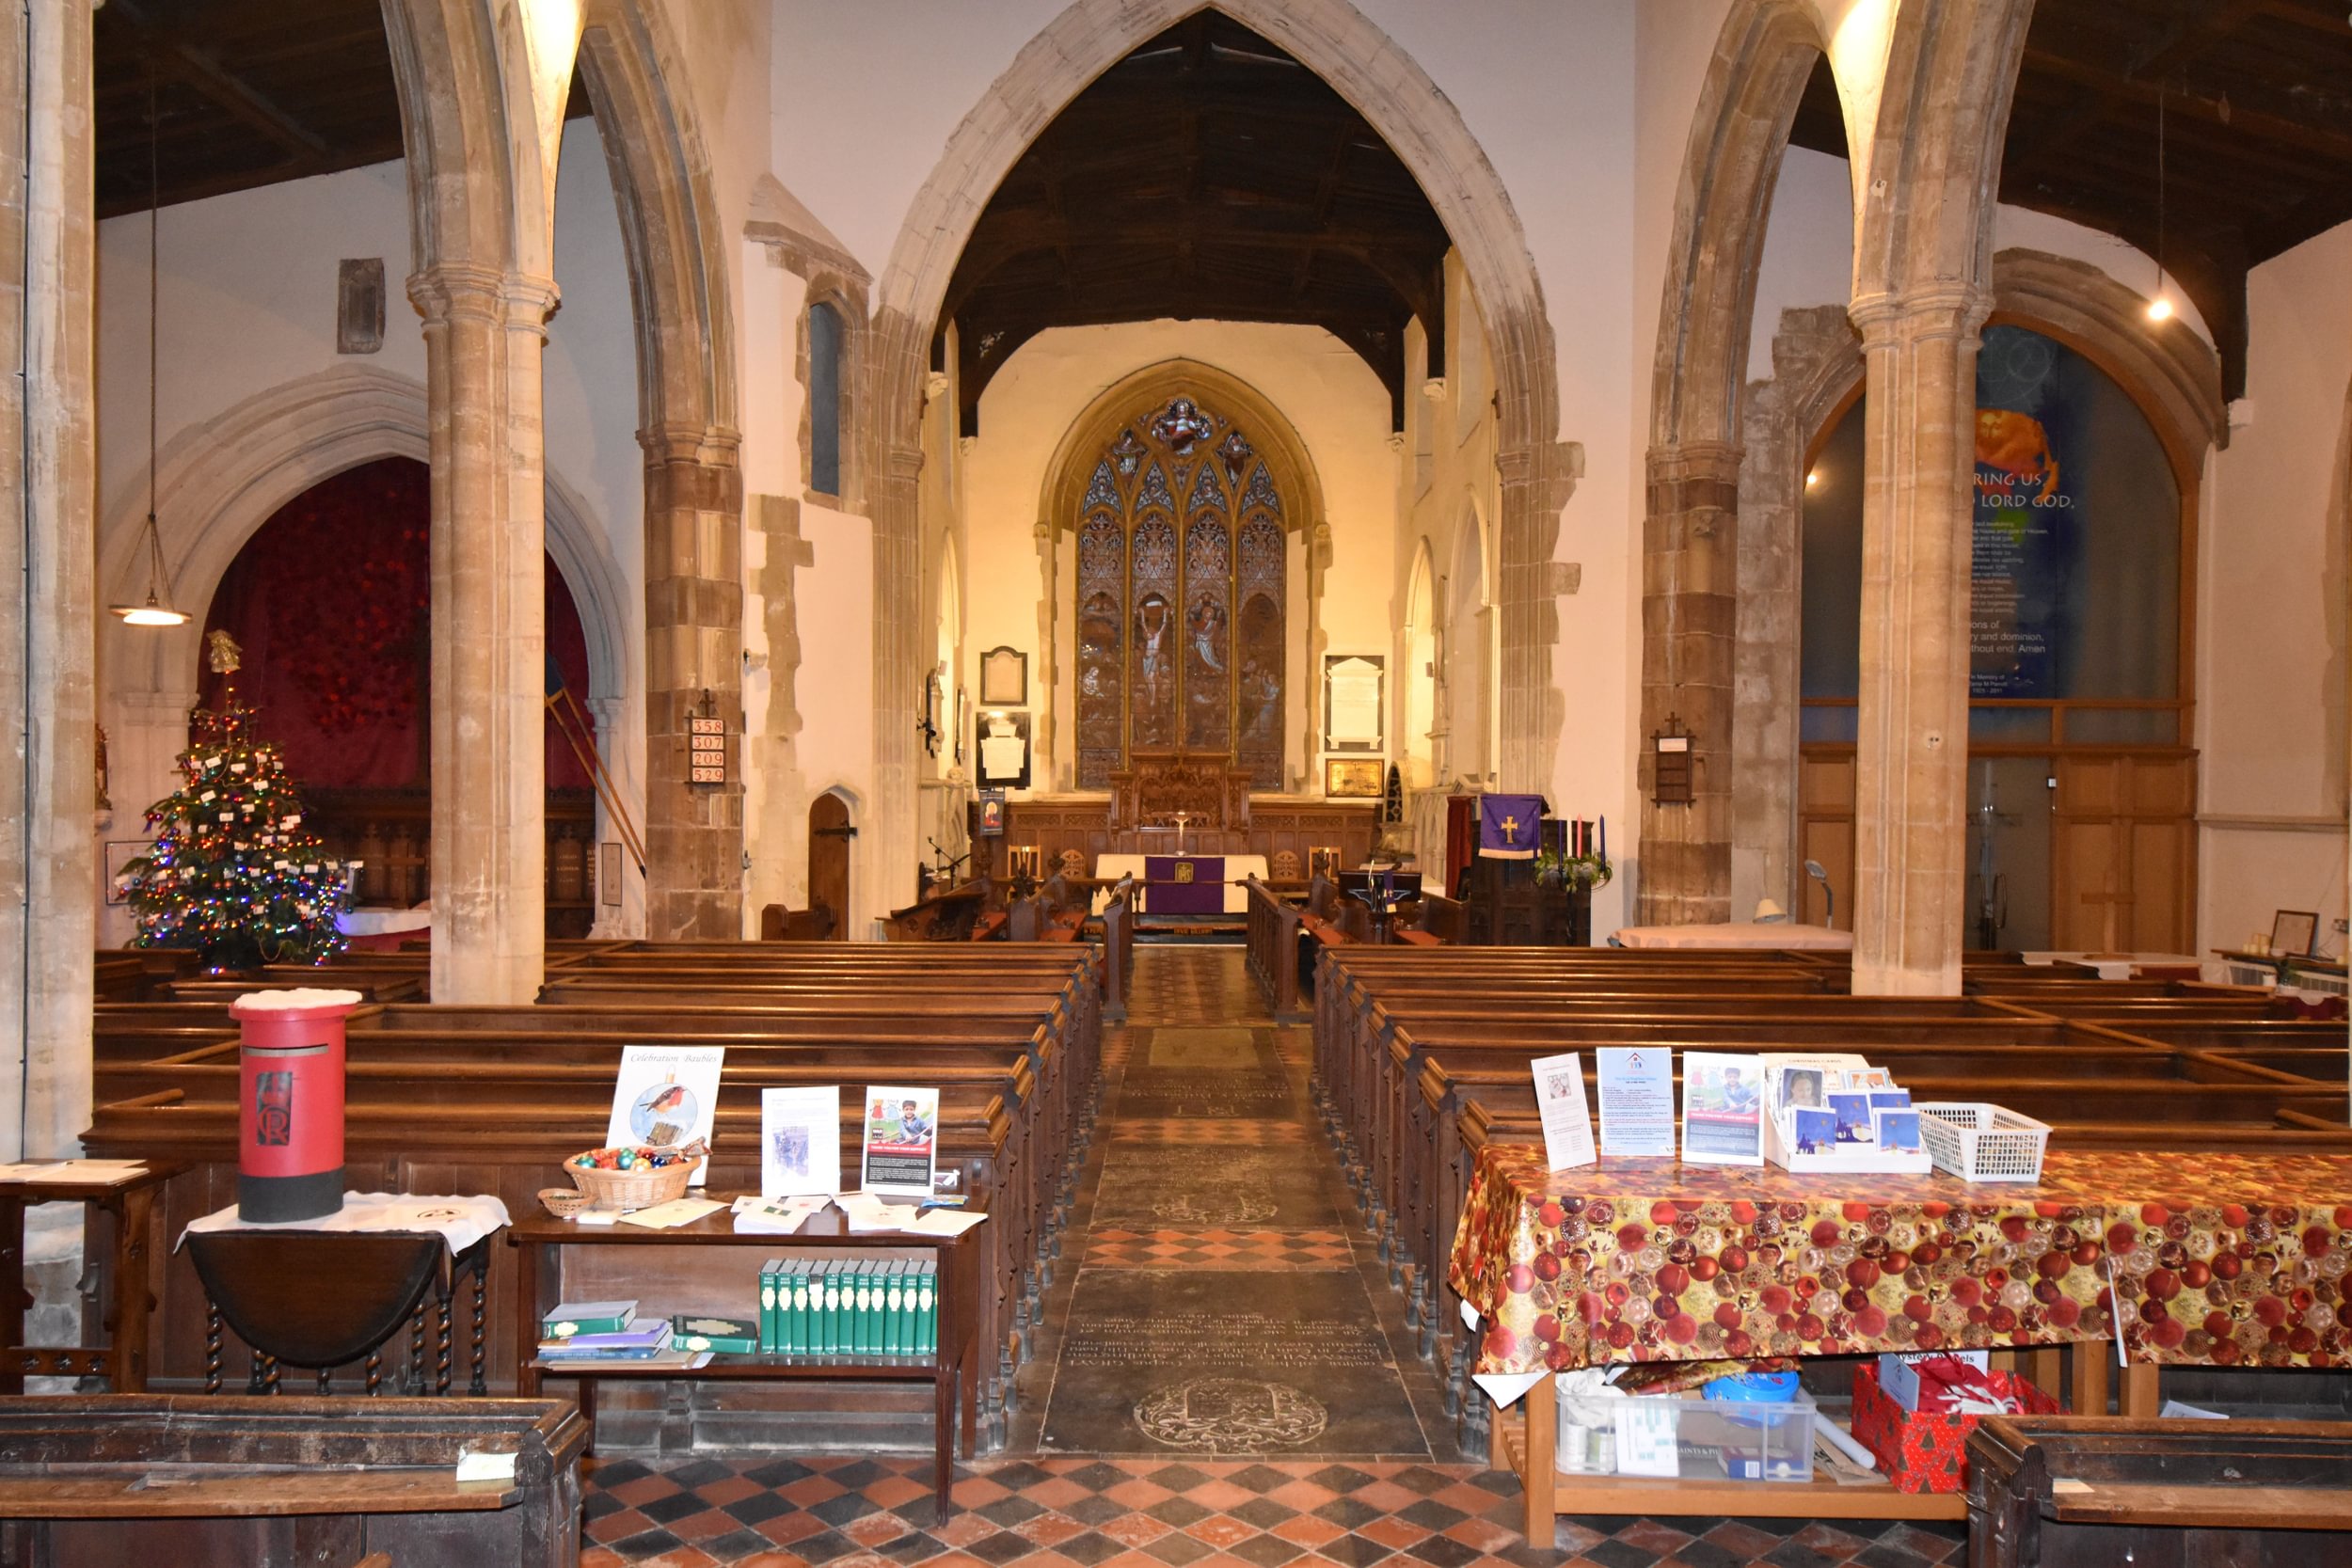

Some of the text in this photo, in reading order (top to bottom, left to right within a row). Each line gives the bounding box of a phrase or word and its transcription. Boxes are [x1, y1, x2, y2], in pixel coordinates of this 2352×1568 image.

[1981, 495, 2026, 508] LORD
[1990, 620, 2000, 629] of
[1980, 632, 1997, 641] and
[2000, 632, 2044, 641] dominion,
[2017, 644, 2046, 653] Amen
[694, 721, 723, 732] 358
[694, 736, 723, 749] 307
[694, 753, 723, 765] 209
[694, 769, 723, 781] 529
[630, 1053, 718, 1063] Celebration Baubles
